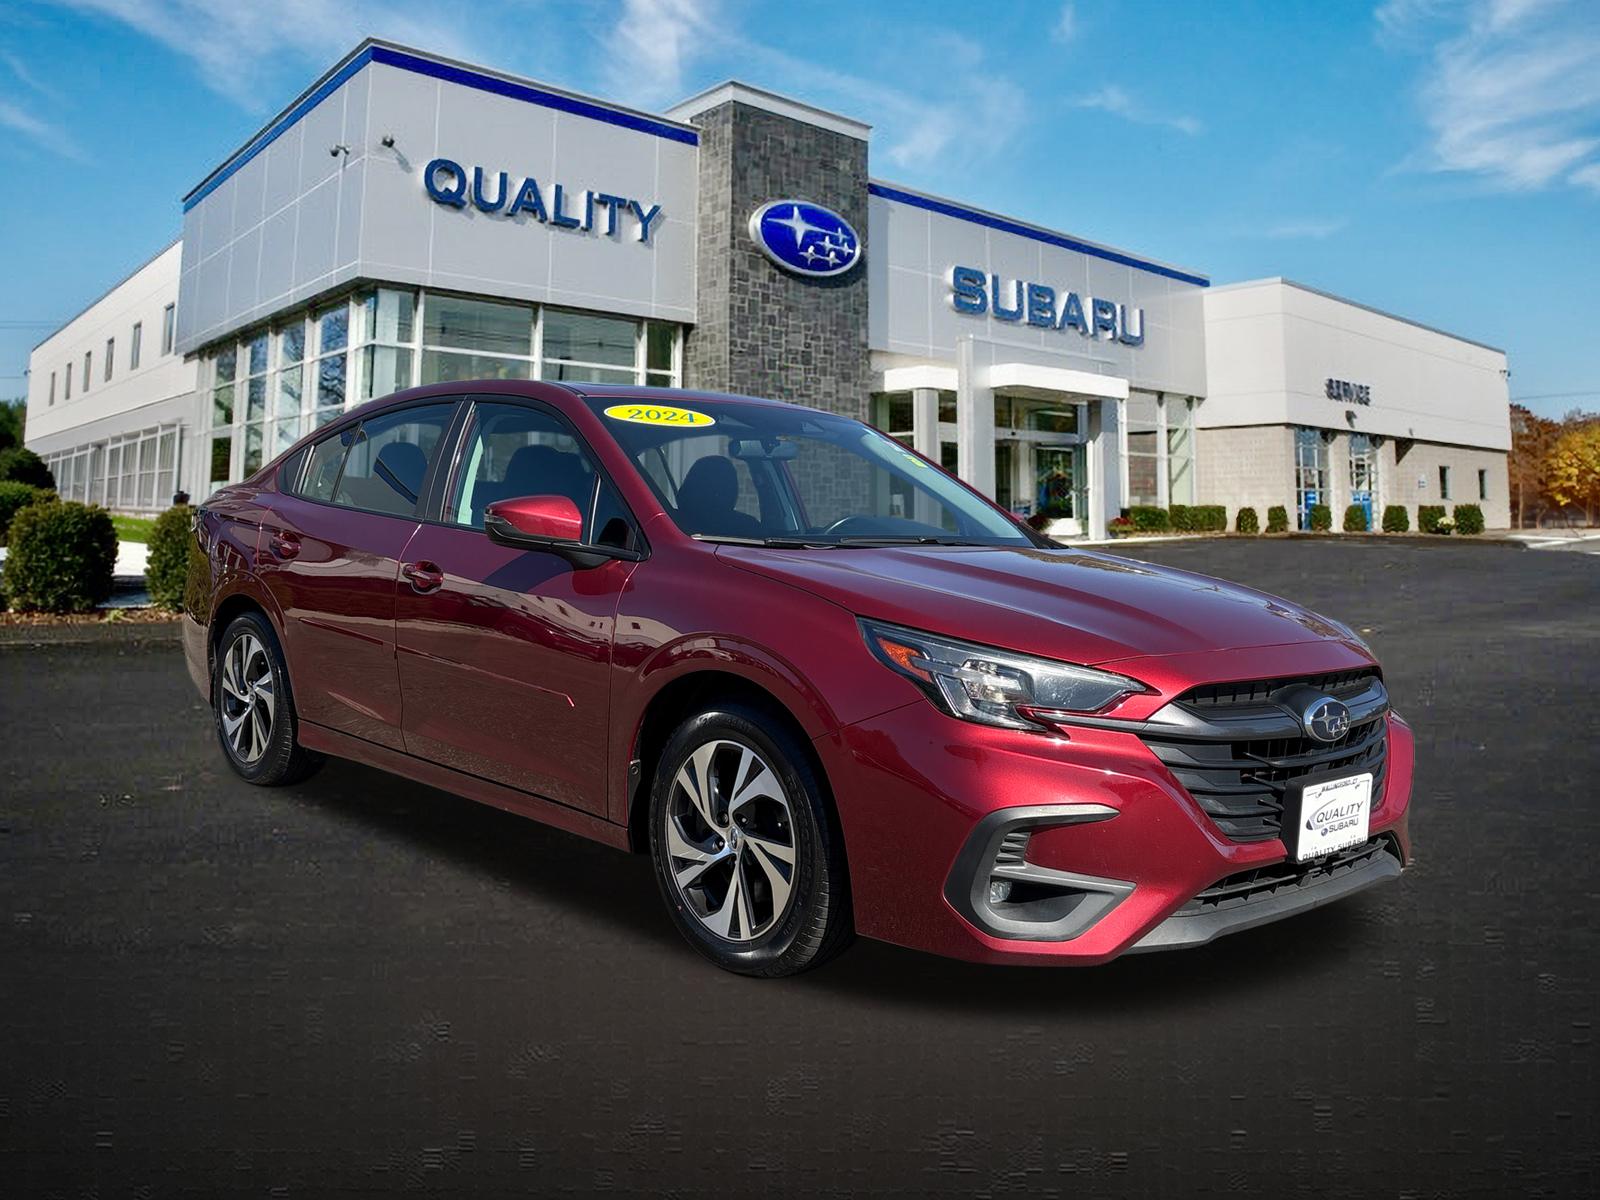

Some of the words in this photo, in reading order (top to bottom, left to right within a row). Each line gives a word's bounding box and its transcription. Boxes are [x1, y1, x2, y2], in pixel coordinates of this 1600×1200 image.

[423, 158, 662, 242] QUALITY
[952, 265, 1145, 346] SUBARU
[627, 408, 698, 424] 2024
[1317, 800, 1364, 823] QUALITY
[1329, 817, 1359, 833] SUBARU
